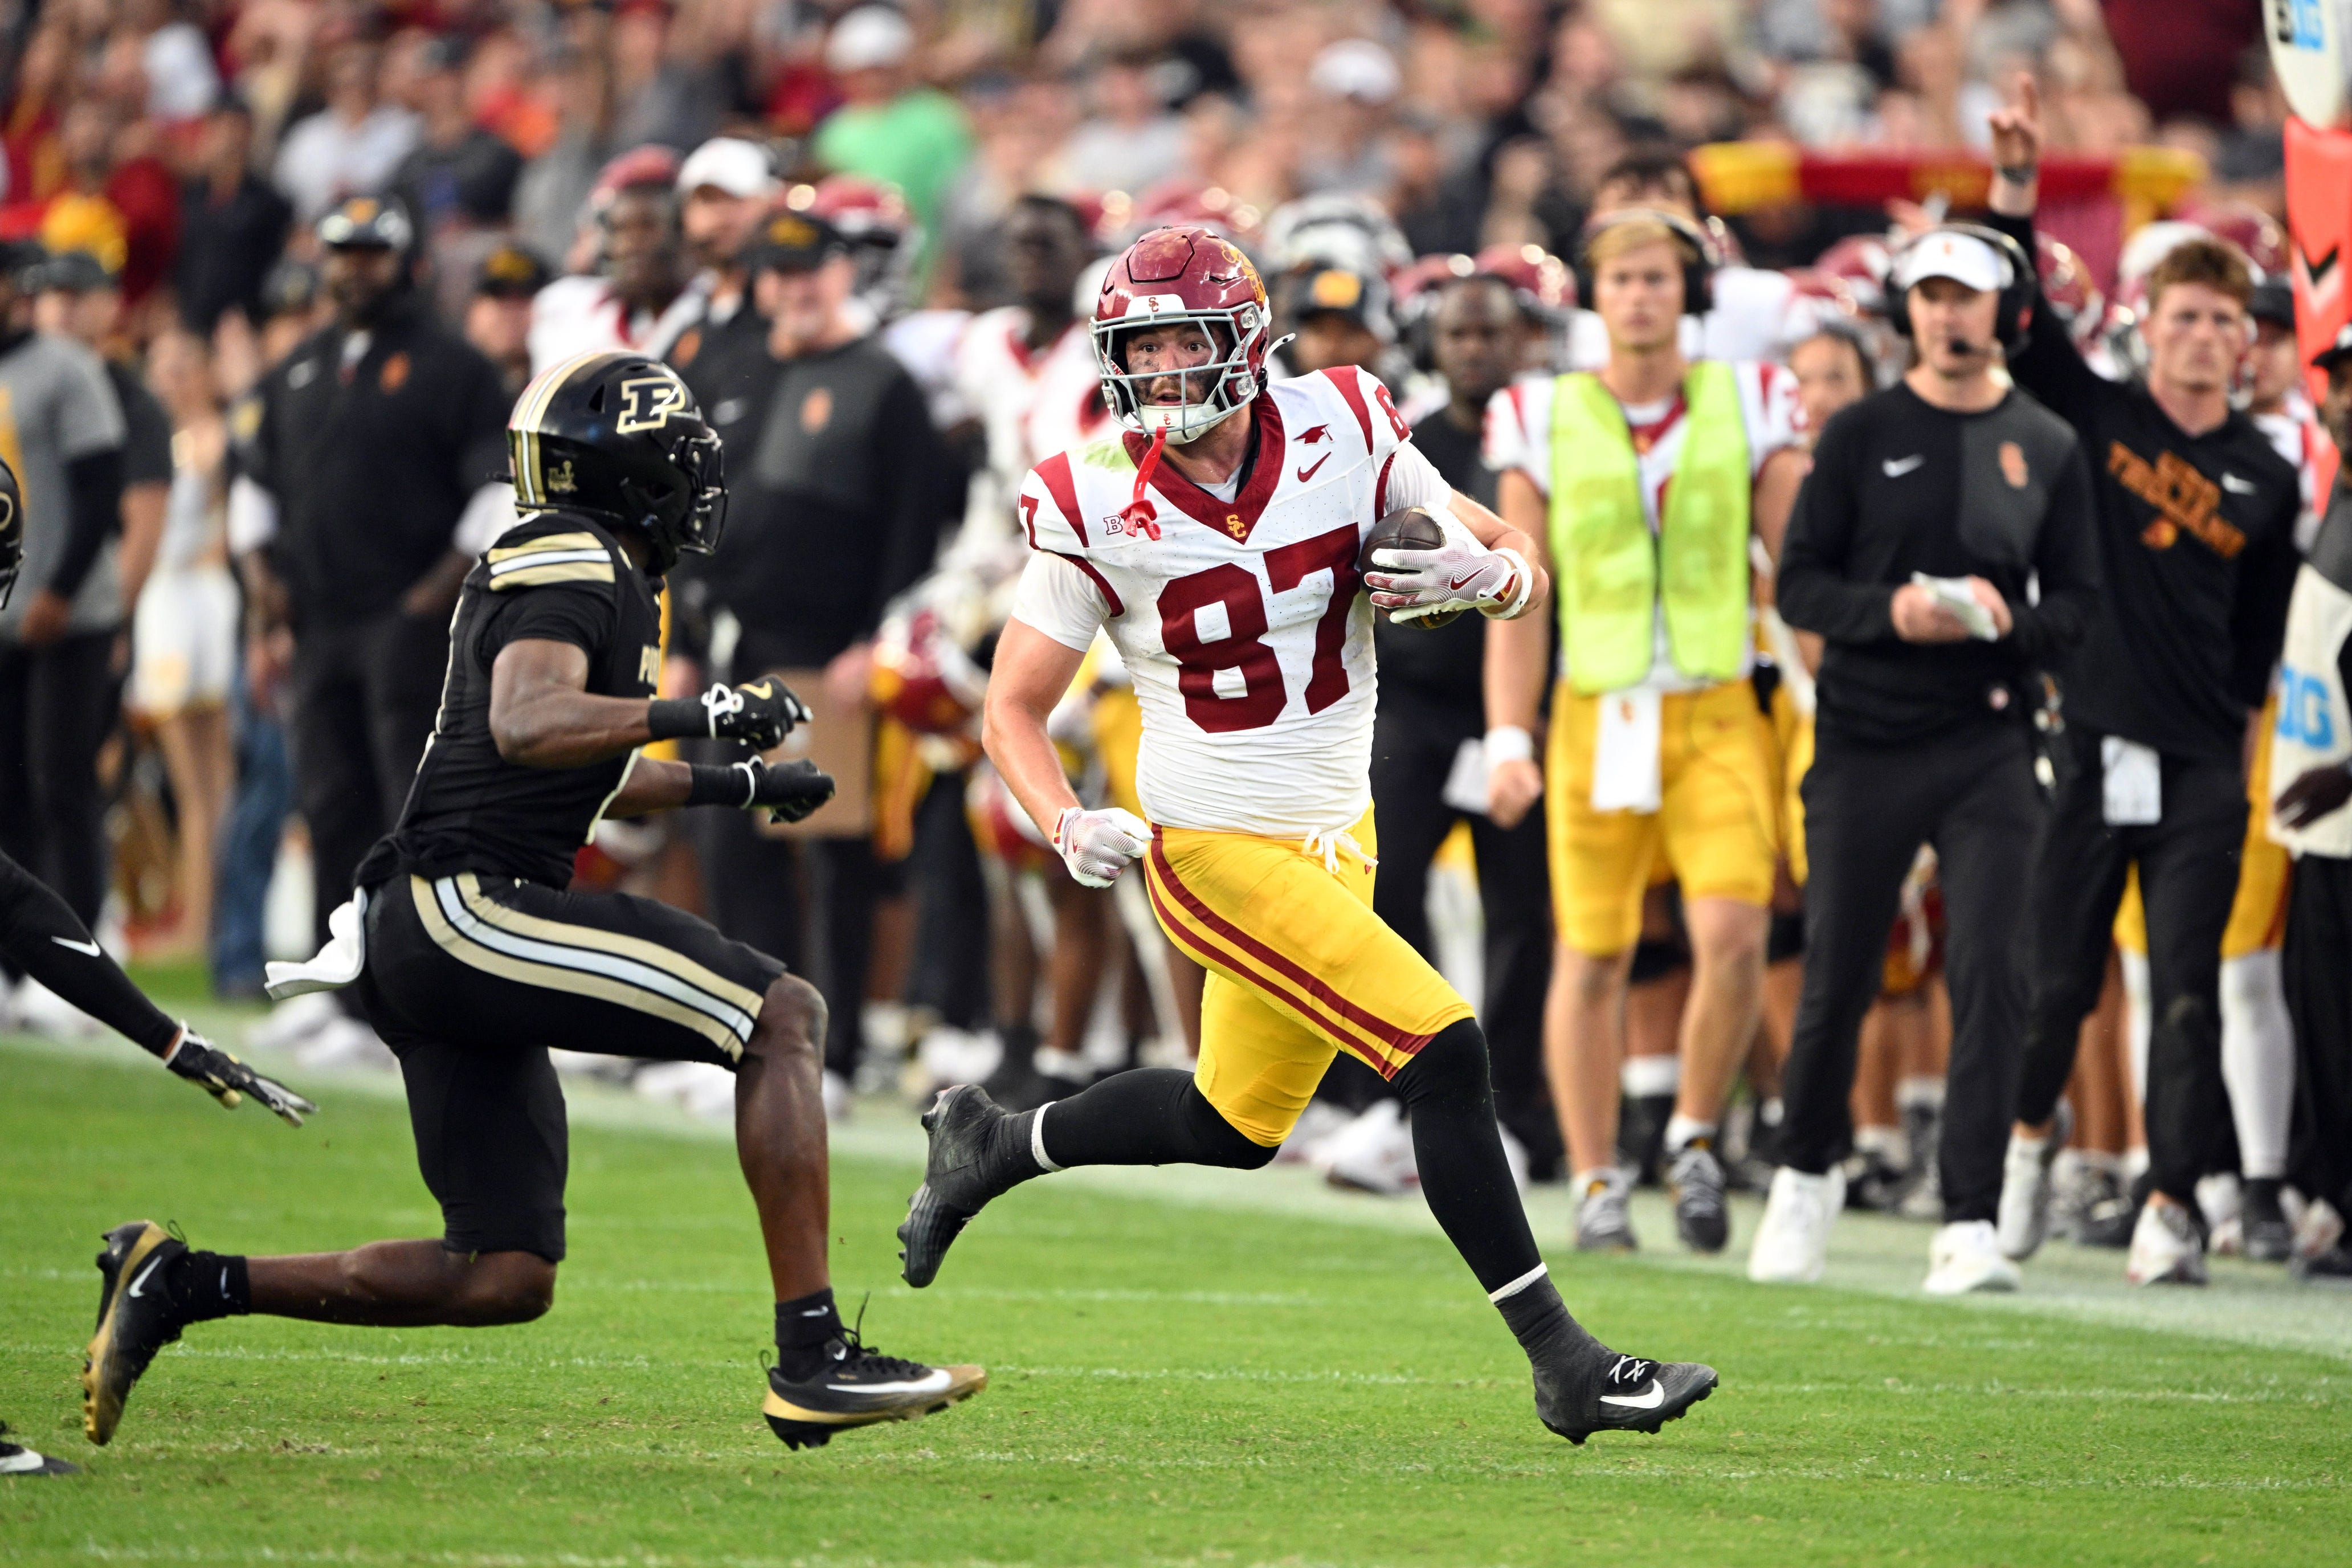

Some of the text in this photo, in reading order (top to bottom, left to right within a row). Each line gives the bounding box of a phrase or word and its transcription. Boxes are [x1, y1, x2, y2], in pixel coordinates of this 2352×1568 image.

[1149, 297, 1159, 312] SC
[616, 376, 685, 434] P
[1163, 414, 1171, 425] SC
[1227, 514, 1247, 538] SC
[1157, 521, 1362, 733] 87
